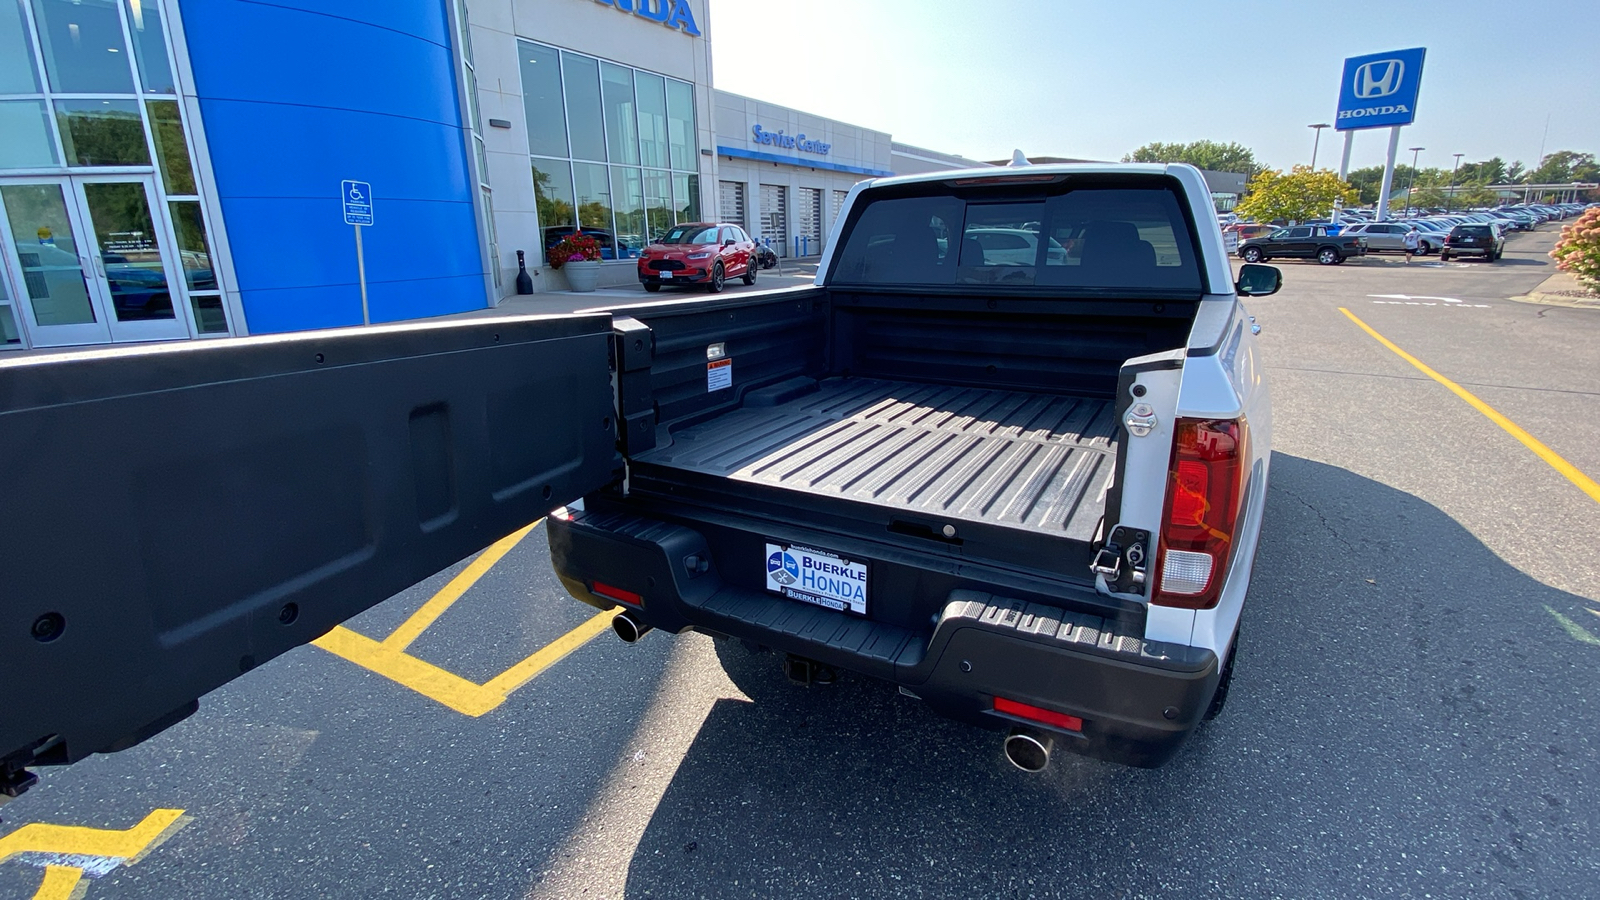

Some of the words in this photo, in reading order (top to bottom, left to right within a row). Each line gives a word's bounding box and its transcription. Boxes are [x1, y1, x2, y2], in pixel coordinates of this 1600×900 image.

[1338, 105, 1409, 119] HONDA
[752, 124, 795, 149] Service
[796, 133, 831, 155] Center
[790, 544, 839, 558] buerklehonda.com
[802, 556, 866, 582] BUERKLE
[802, 568, 865, 602] HONDA
[788, 589, 821, 604] BUERKLE
[821, 597, 843, 610] HONDA
